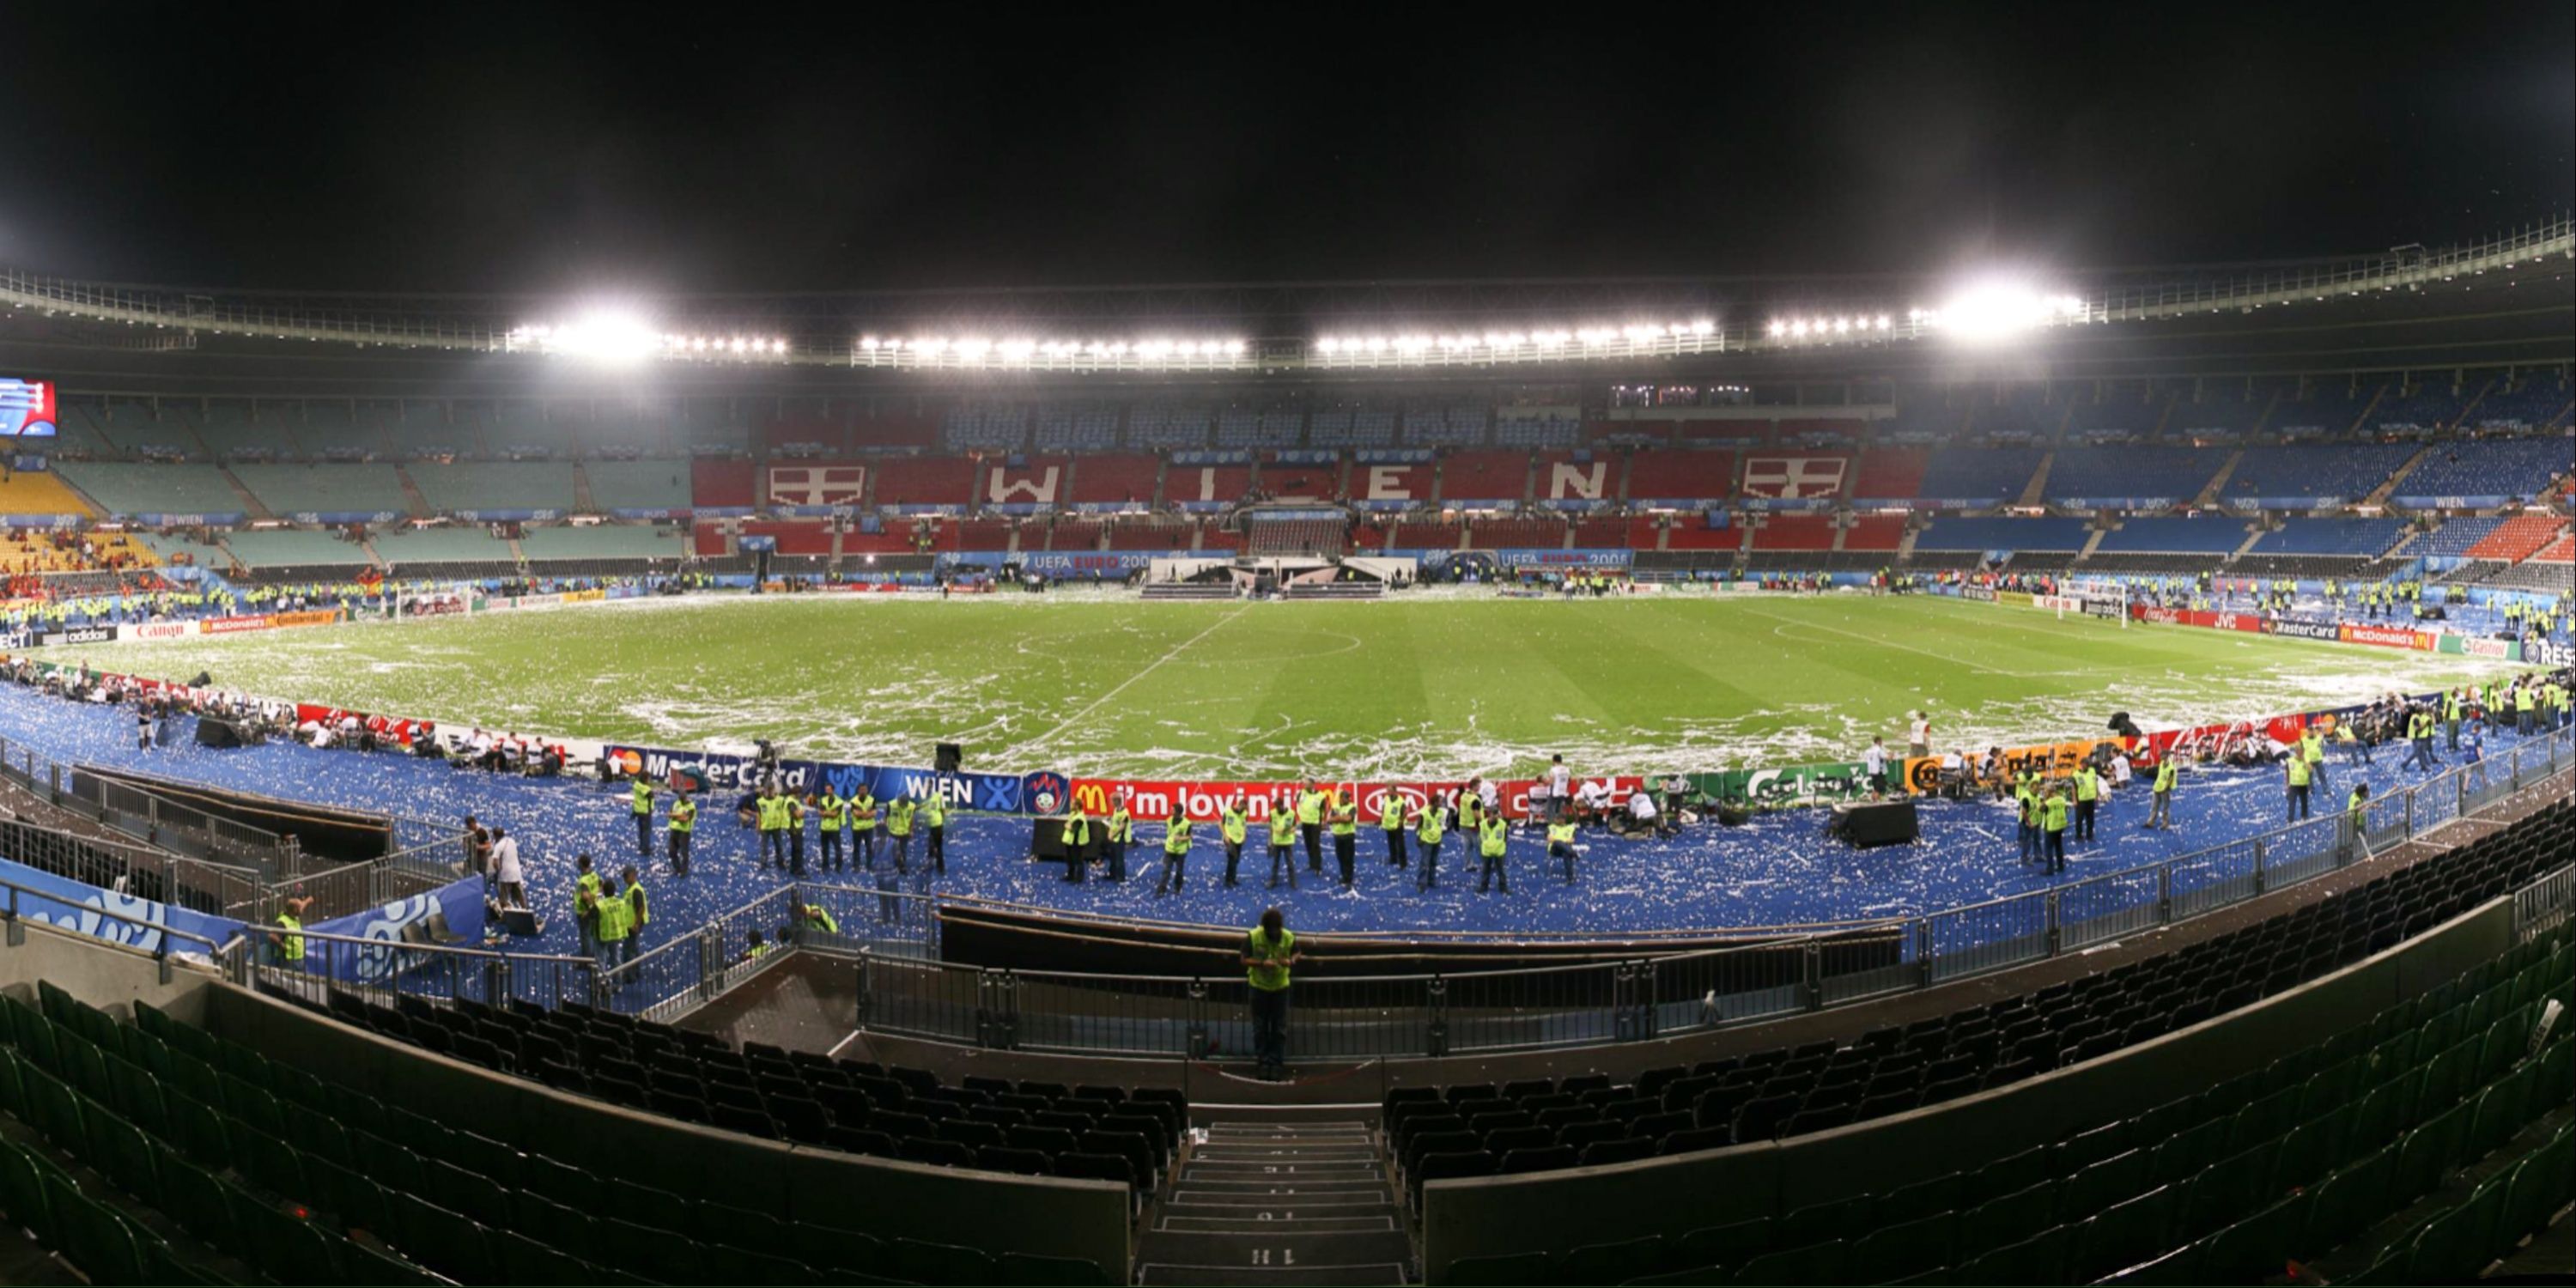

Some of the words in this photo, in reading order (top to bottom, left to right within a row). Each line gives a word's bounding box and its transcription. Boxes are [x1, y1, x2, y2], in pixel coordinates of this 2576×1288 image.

[2435, 496, 2464, 508] WIEN
[176, 514, 204, 526] WIEN
[1034, 556, 1072, 569] UEFA
[1121, 556, 1155, 568] 200
[1501, 554, 1539, 567] UEFA
[212, 616, 264, 630] McDonald's
[2214, 613, 2237, 629] JVC
[68, 629, 108, 643] adidas
[137, 624, 184, 637] Canon
[2353, 629, 2415, 646] McDonald's
[906, 775, 973, 805] WIEN
